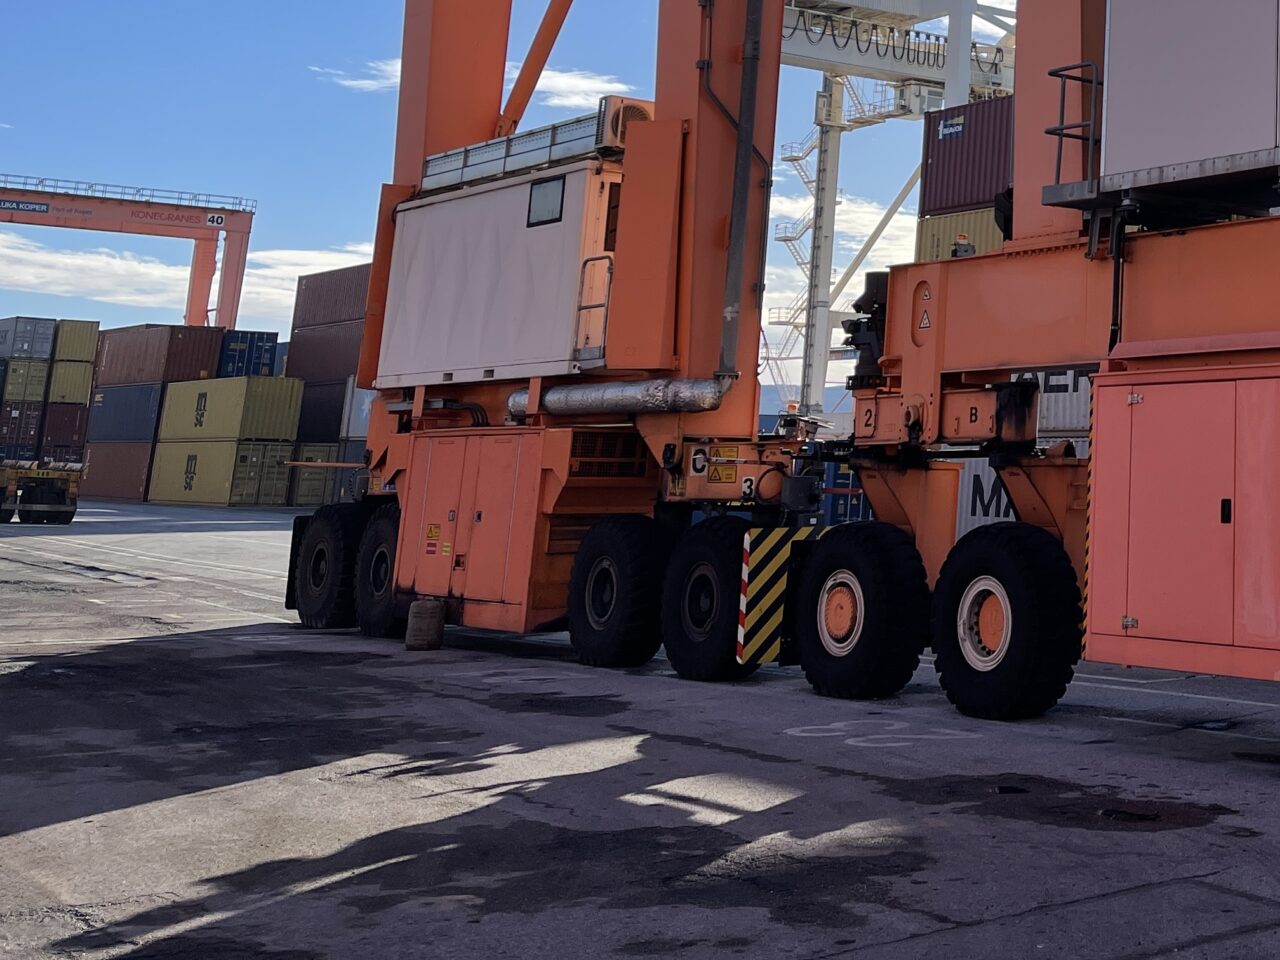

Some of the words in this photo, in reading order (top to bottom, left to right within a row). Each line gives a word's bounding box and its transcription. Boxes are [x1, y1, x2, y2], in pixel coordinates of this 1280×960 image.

[19, 203, 48, 212] KOPER
[208, 215, 224, 225] 40
[864, 408, 873, 428] 2
[969, 406, 978, 423] B
[692, 449, 707, 473] C
[743, 478, 754, 497] 3
